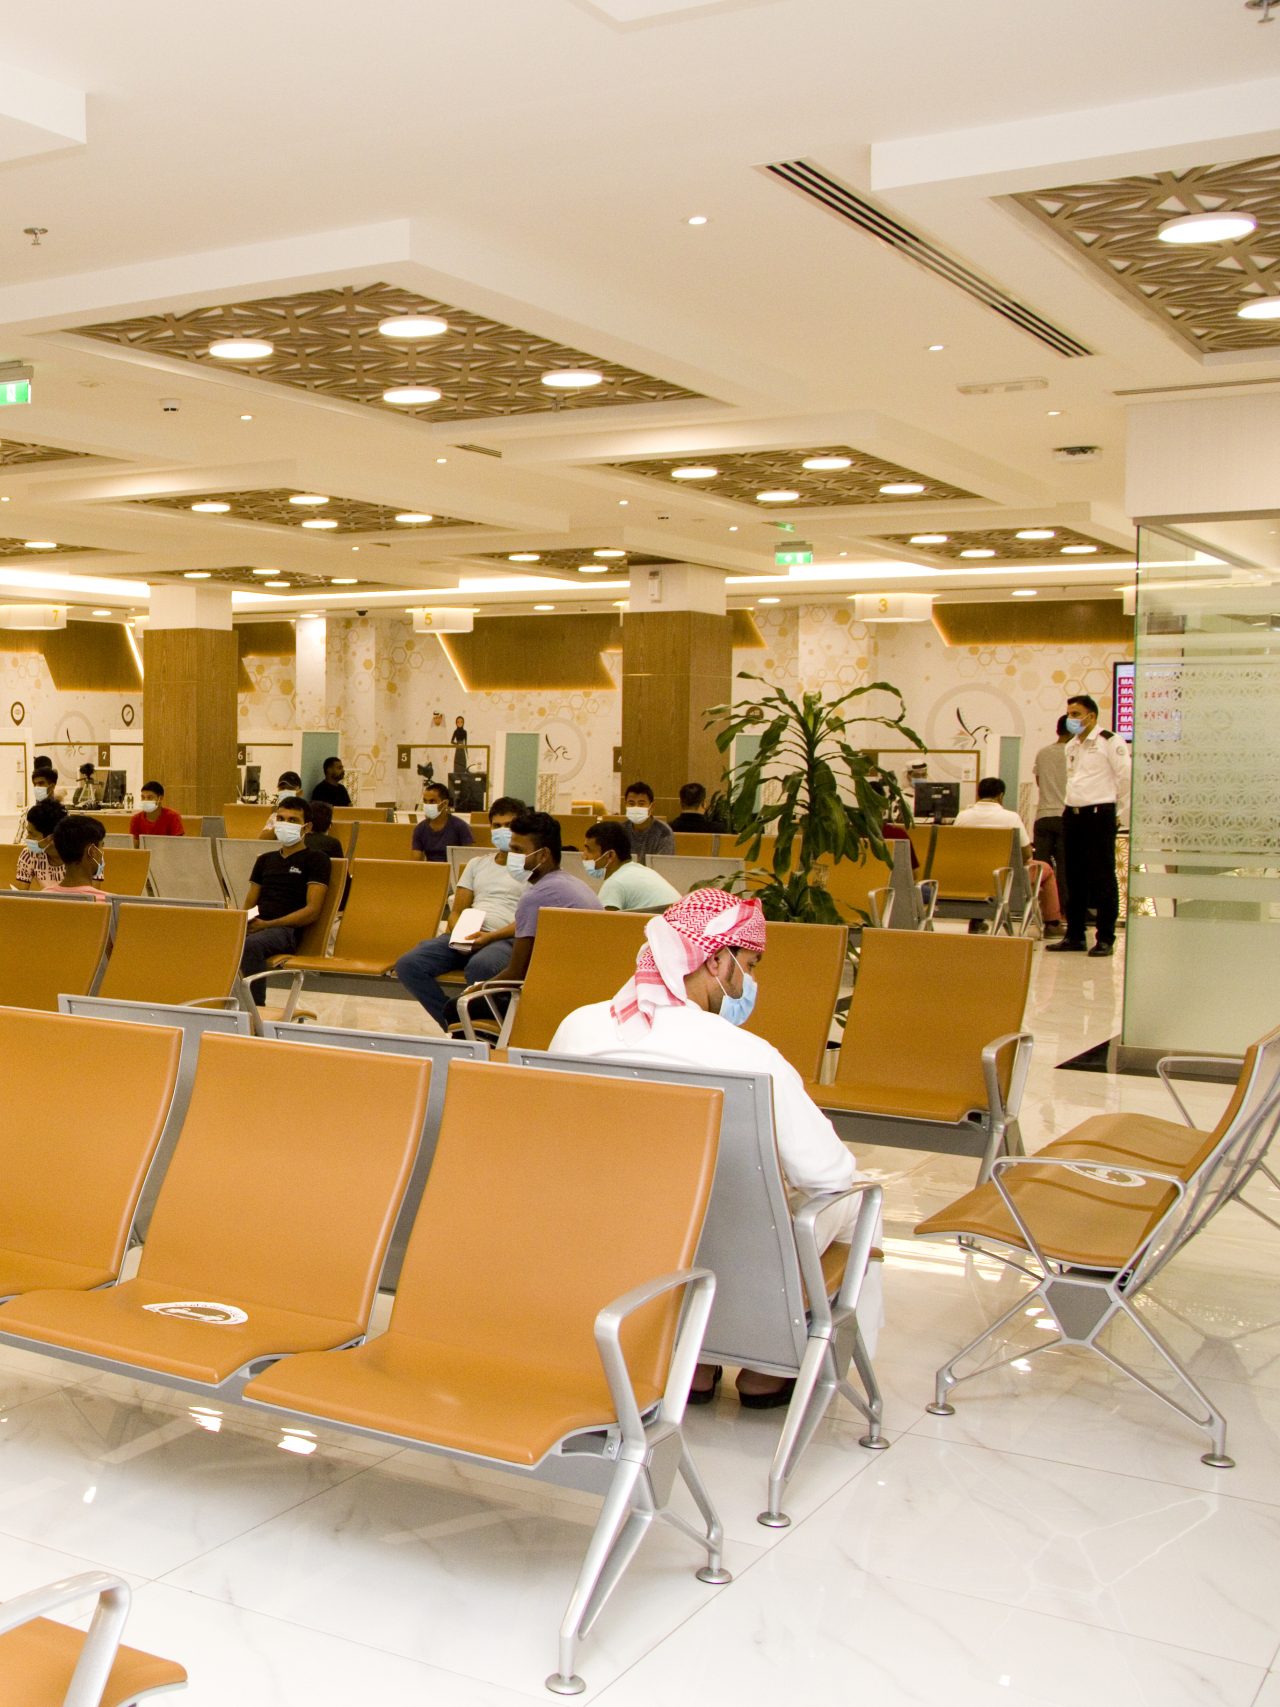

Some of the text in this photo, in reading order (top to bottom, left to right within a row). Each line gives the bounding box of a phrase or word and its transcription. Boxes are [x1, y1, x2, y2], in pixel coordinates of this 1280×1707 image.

[878, 598, 888, 613] 3
[52, 609, 60, 623] 7
[424, 612, 433, 626] 5
[101, 751, 107, 760] 7
[237, 751, 243, 760] 6
[401, 752, 407, 762] 5
